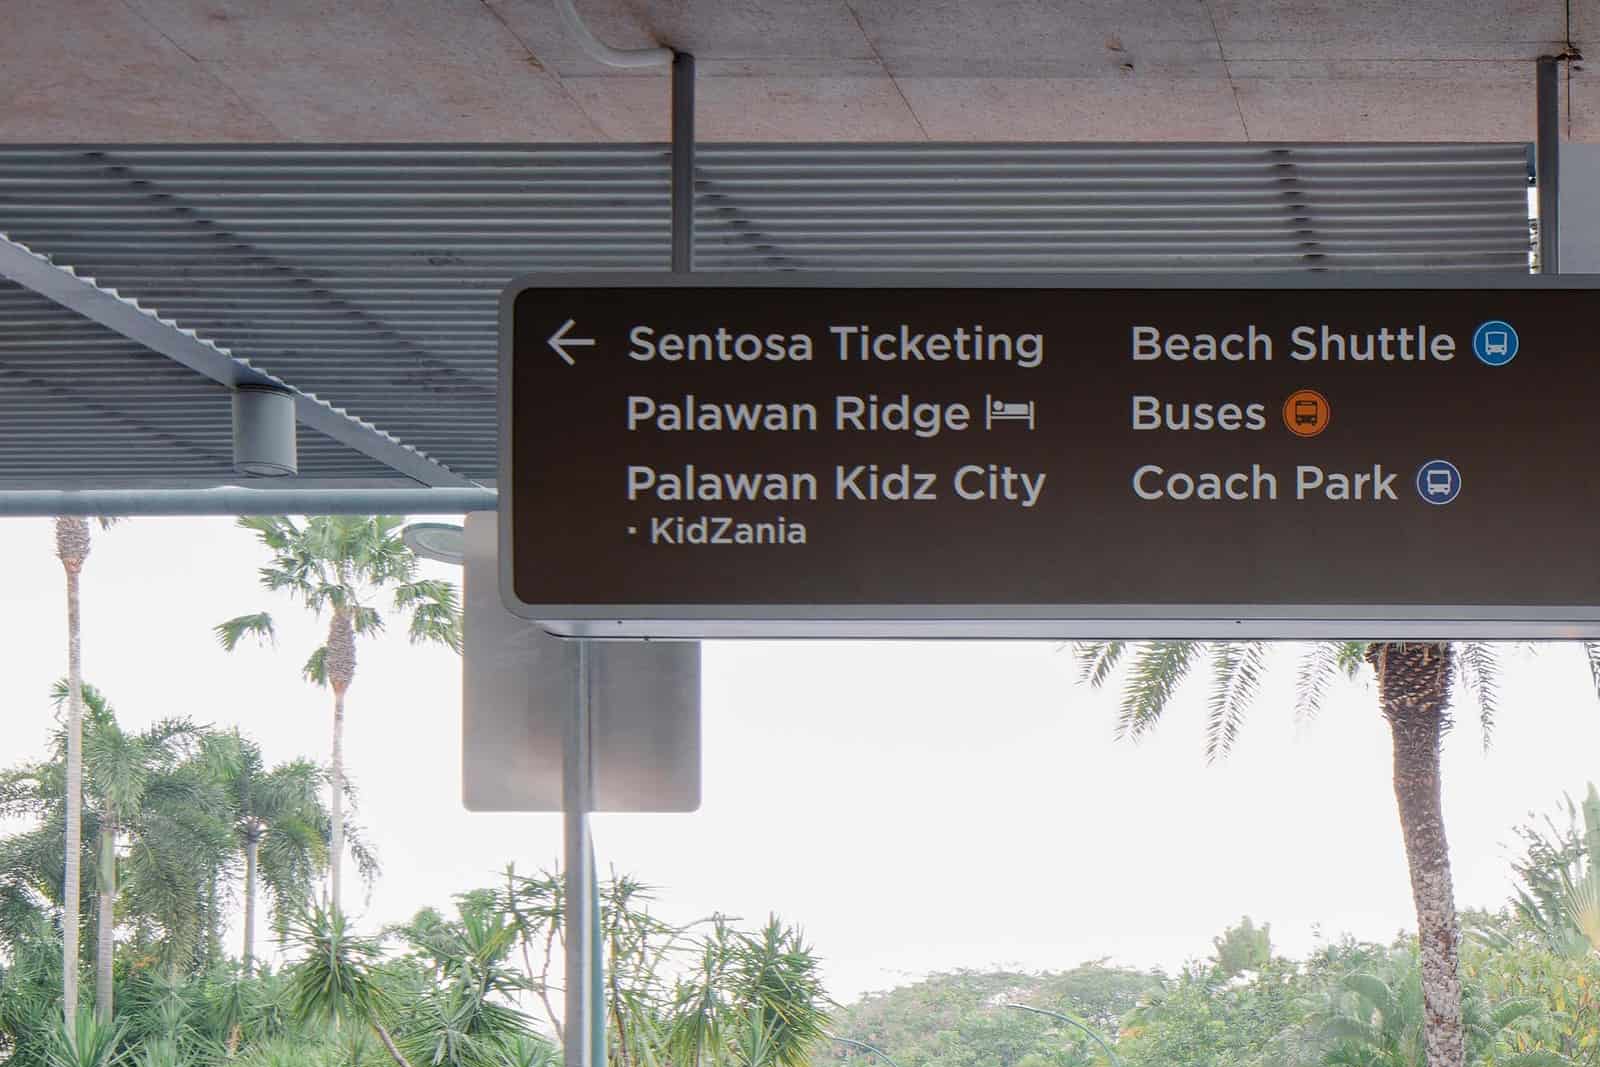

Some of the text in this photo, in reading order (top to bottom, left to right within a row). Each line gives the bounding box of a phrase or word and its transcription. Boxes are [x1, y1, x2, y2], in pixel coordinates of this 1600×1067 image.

[628, 324, 1044, 368] Sentosa Ticketing
[1132, 324, 1456, 361] Beach Shuttle
[628, 394, 971, 438] Palawan Ridge
[1132, 395, 1266, 431] Buses
[628, 463, 1047, 508] Palawan Kidz City
[1132, 463, 1399, 501] Coach Park
[651, 515, 807, 545] KidZania
